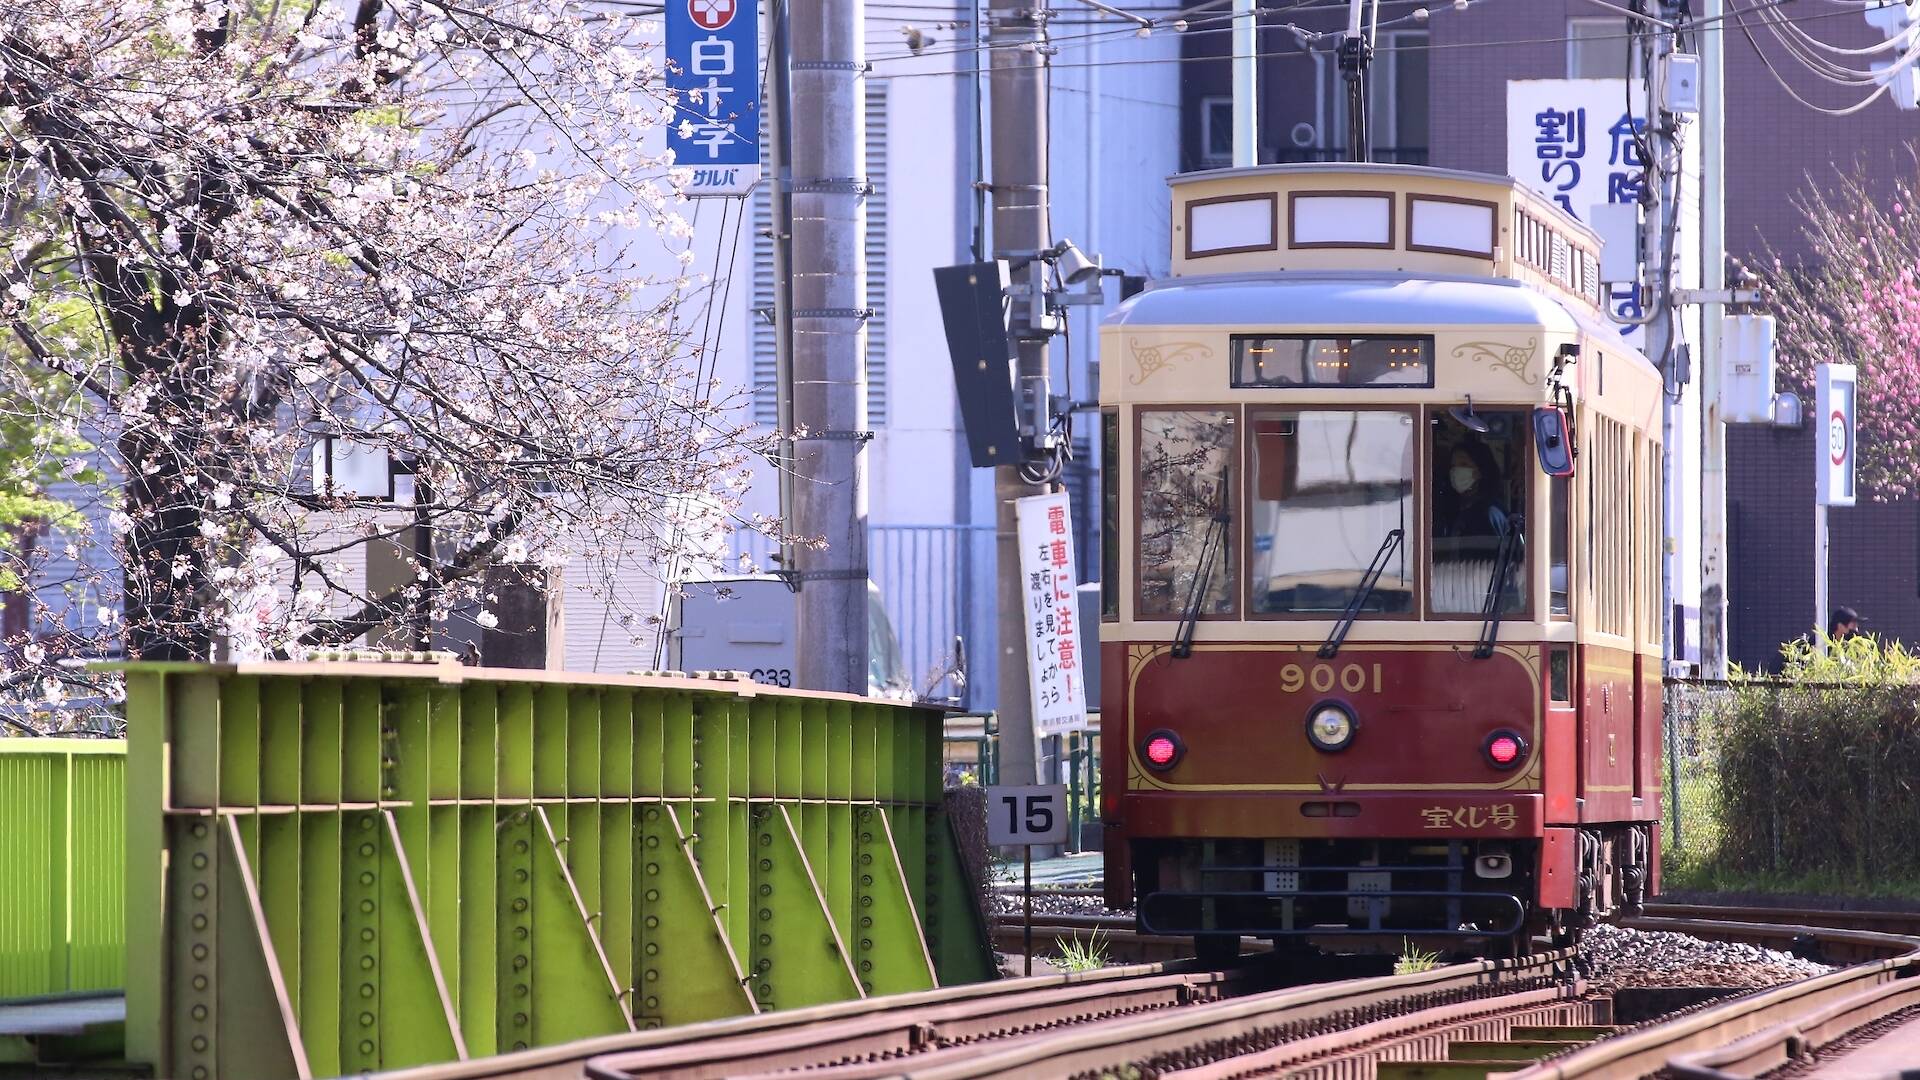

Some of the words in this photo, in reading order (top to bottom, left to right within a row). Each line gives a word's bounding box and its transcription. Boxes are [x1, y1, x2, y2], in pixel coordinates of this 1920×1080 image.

[691, 35, 736, 158] 白十字
[693, 168, 739, 187] サルバ
[1831, 426, 1844, 450] 50
[1030, 572, 1050, 708] 渡りましょう
[1038, 544, 1060, 704] 左右を見てから
[1280, 663, 1382, 693] 9001
[1003, 796, 1054, 835] 15
[1420, 803, 1520, 831] 宝くじ号
